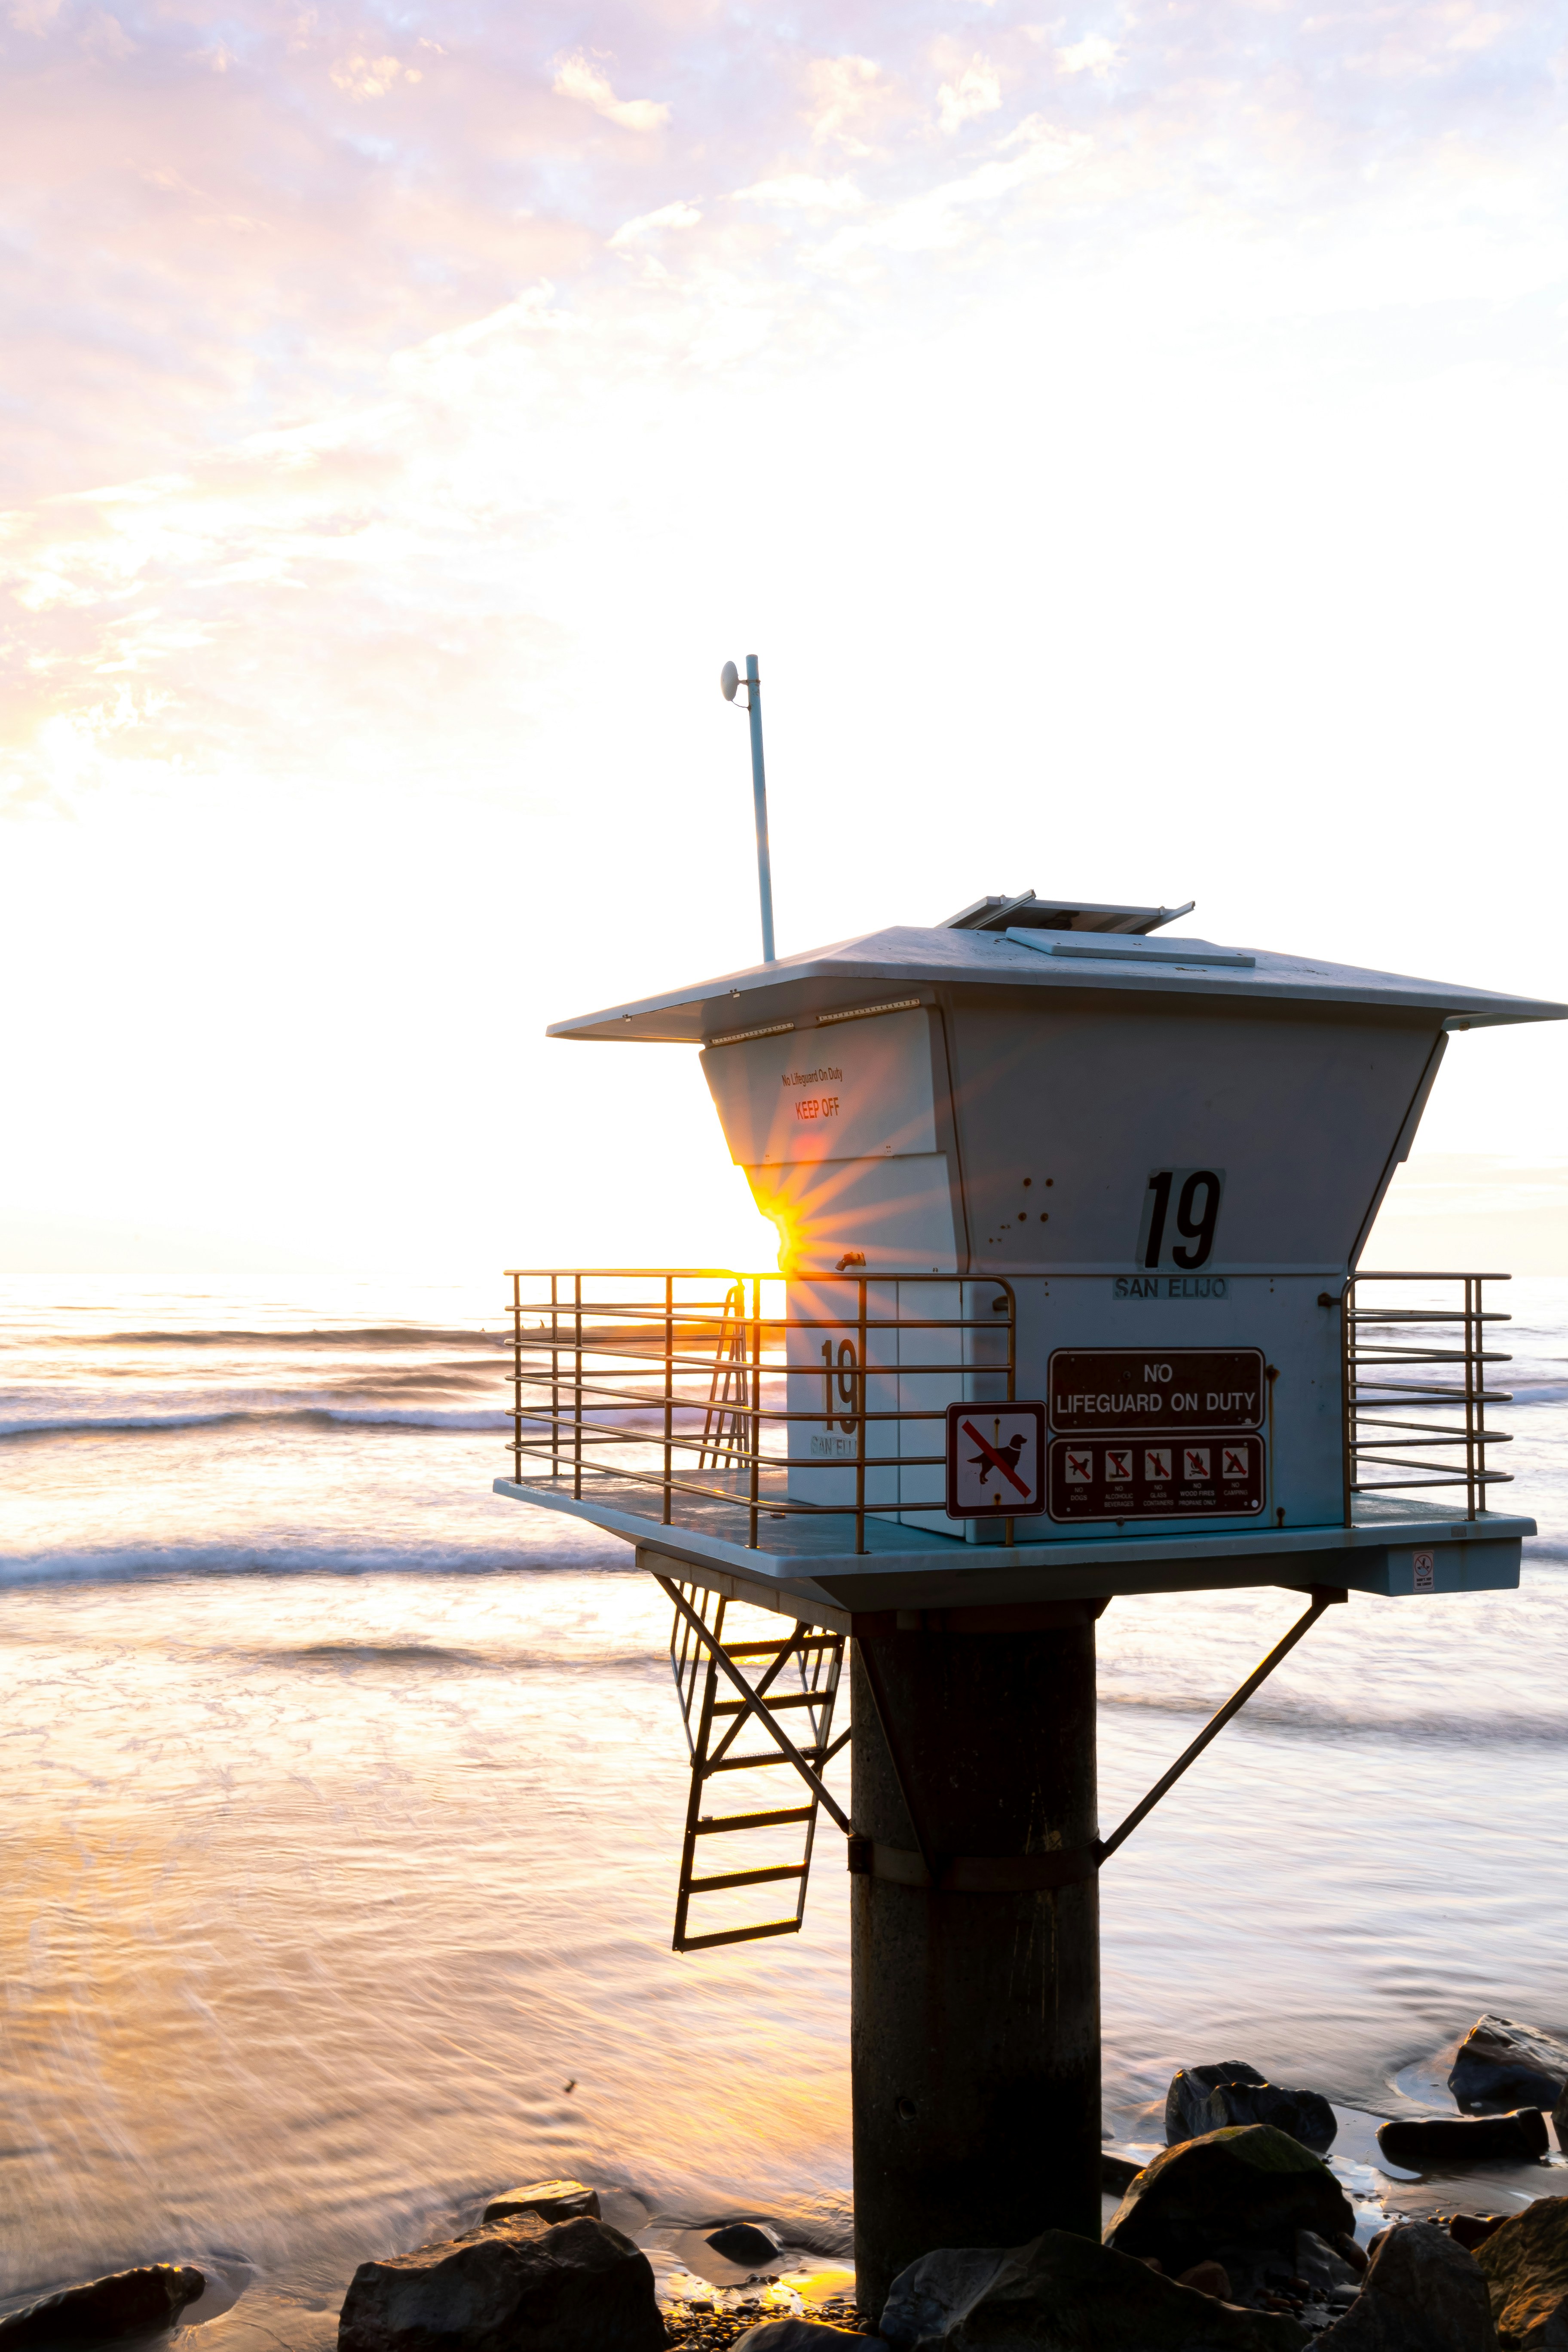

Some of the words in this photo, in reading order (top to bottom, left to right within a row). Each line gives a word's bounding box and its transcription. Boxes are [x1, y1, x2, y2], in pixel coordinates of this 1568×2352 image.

[781, 1075, 790, 1087] No
[791, 1069, 818, 1087] Lifeguard
[818, 1069, 828, 1081] On
[828, 1067, 842, 1082] Duty
[795, 1100, 819, 1120] KEEP
[822, 1097, 839, 1117] OFF
[1145, 1170, 1221, 1270] 19
[1115, 1278, 1158, 1297] SAN
[1169, 1278, 1226, 1297] ELIJO
[1144, 1364, 1173, 1382] NO
[821, 1339, 857, 1434] 19
[1057, 1393, 1162, 1413] LIFEGUARD
[1171, 1393, 1197, 1411] ON
[1207, 1392, 1255, 1410] DUTY
